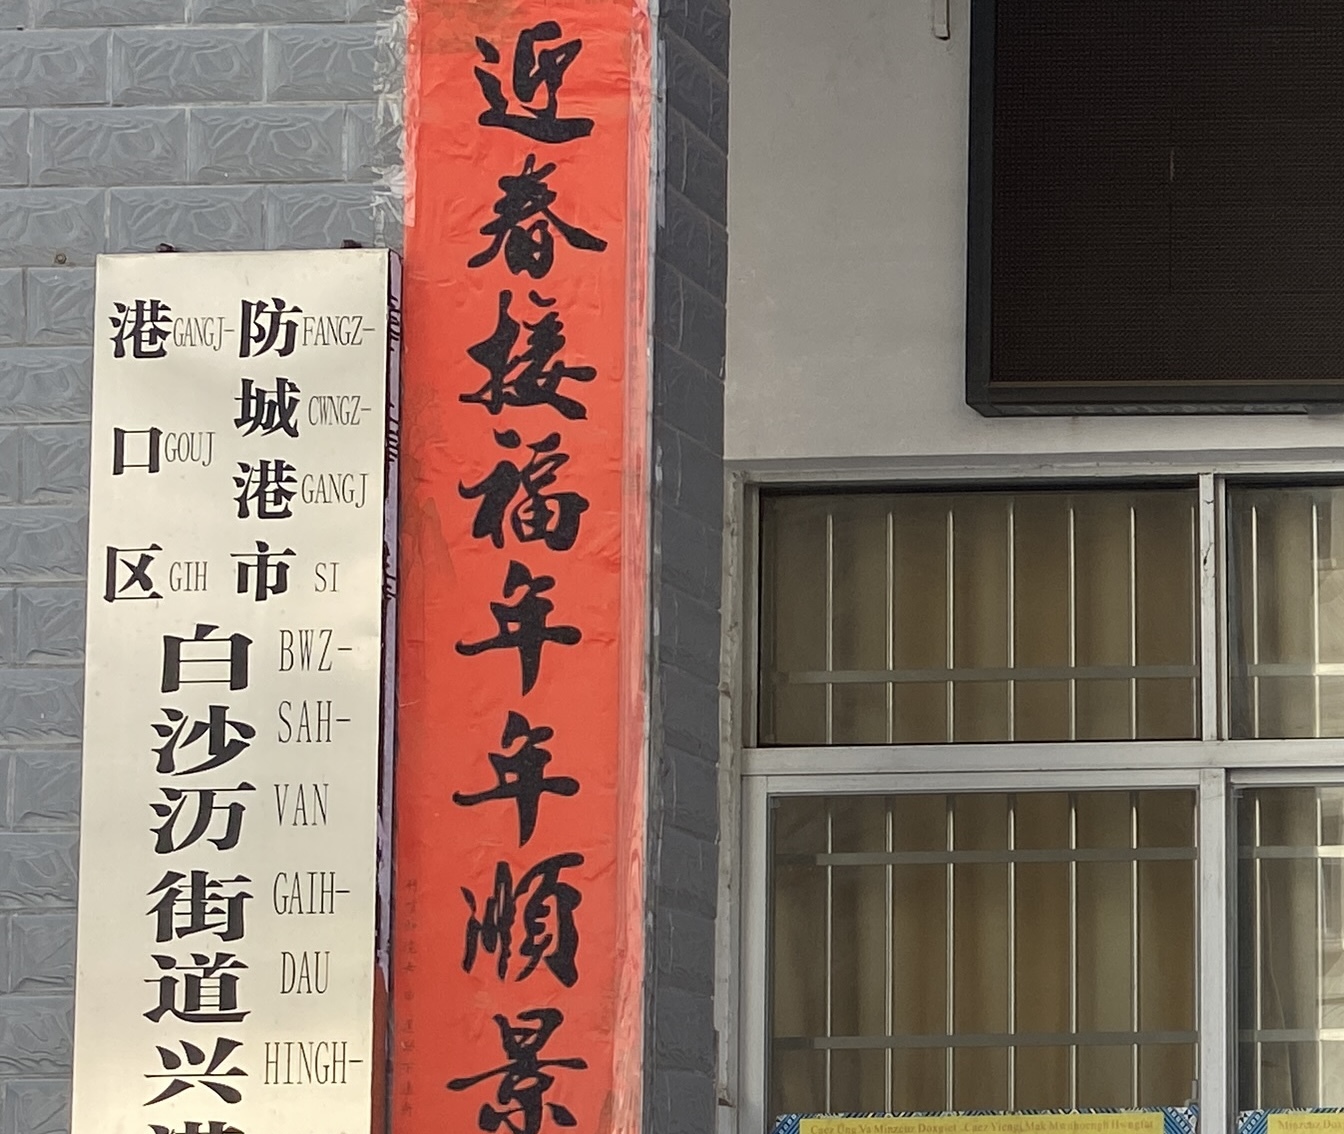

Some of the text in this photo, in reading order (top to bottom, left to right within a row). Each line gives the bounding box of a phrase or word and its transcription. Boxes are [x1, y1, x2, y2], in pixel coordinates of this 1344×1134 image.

[104, 300, 173, 603] 港口区
[230, 297, 303, 603] 防城港市
[278, 629, 353, 672] BWZ-
[277, 700, 352, 744] SAH-
[273, 783, 329, 827] VAN
[272, 871, 351, 915] GAIH-
[280, 951, 331, 995] DAU
